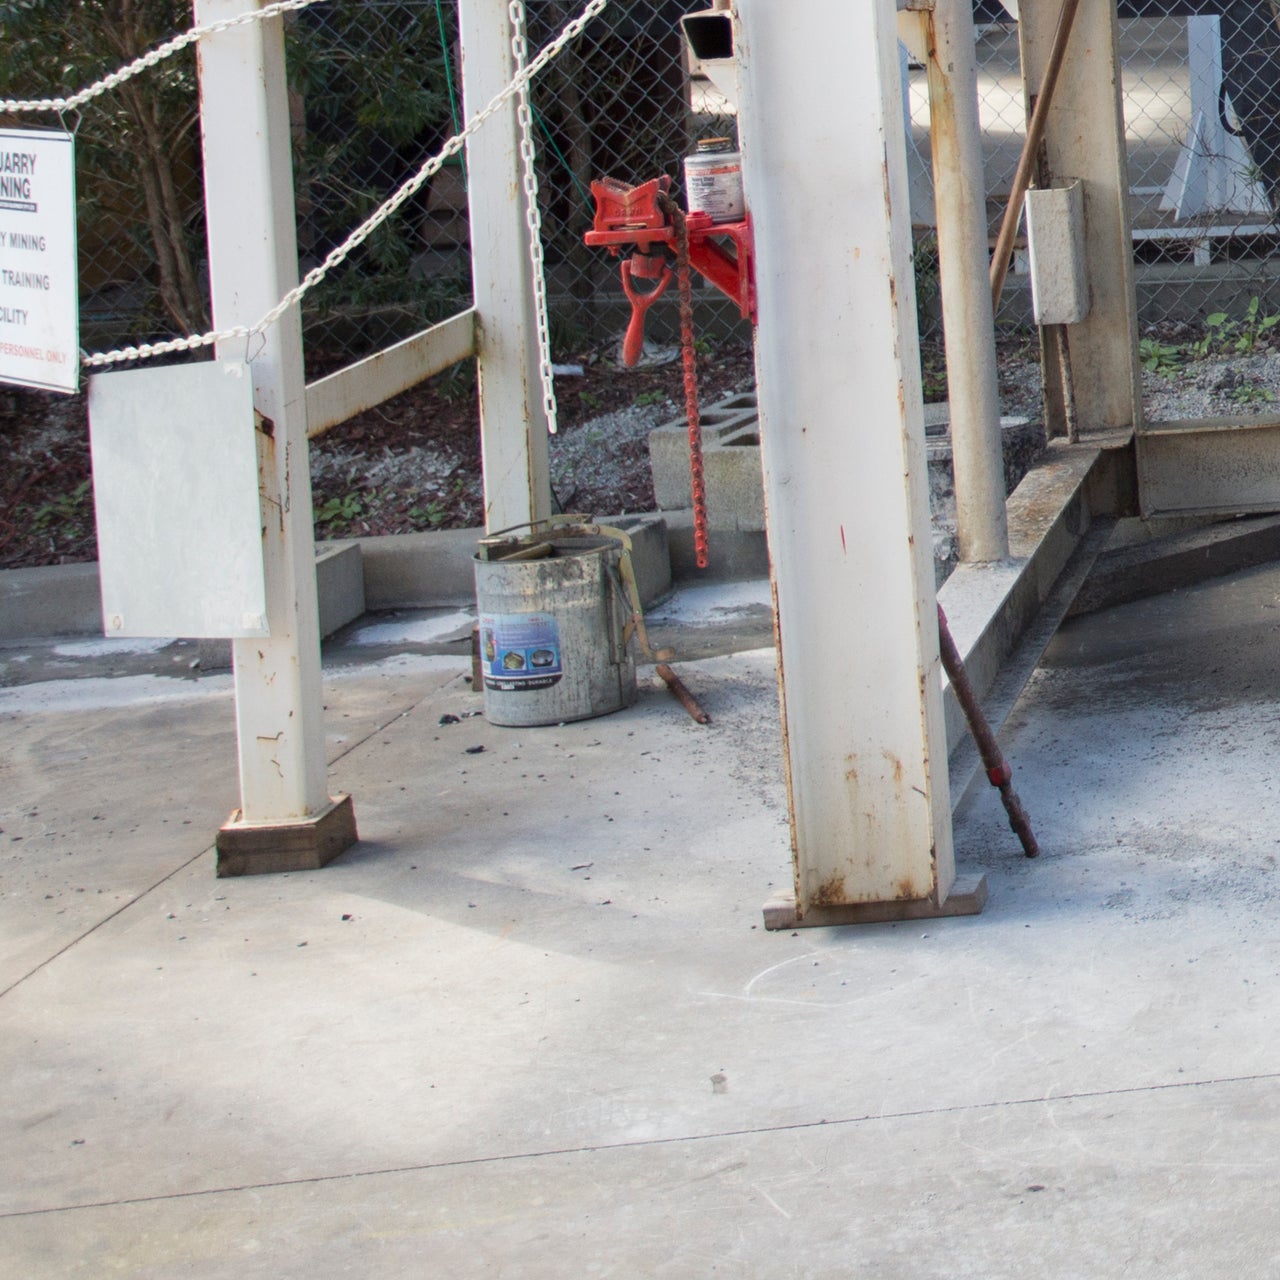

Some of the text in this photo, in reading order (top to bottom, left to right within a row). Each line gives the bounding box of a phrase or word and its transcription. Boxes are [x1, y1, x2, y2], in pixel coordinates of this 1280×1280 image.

[0, 176, 31, 199] NING
[10, 232, 46, 252] MINING
[2, 269, 50, 291] TRAINING
[47, 350, 67, 364] ONLY
